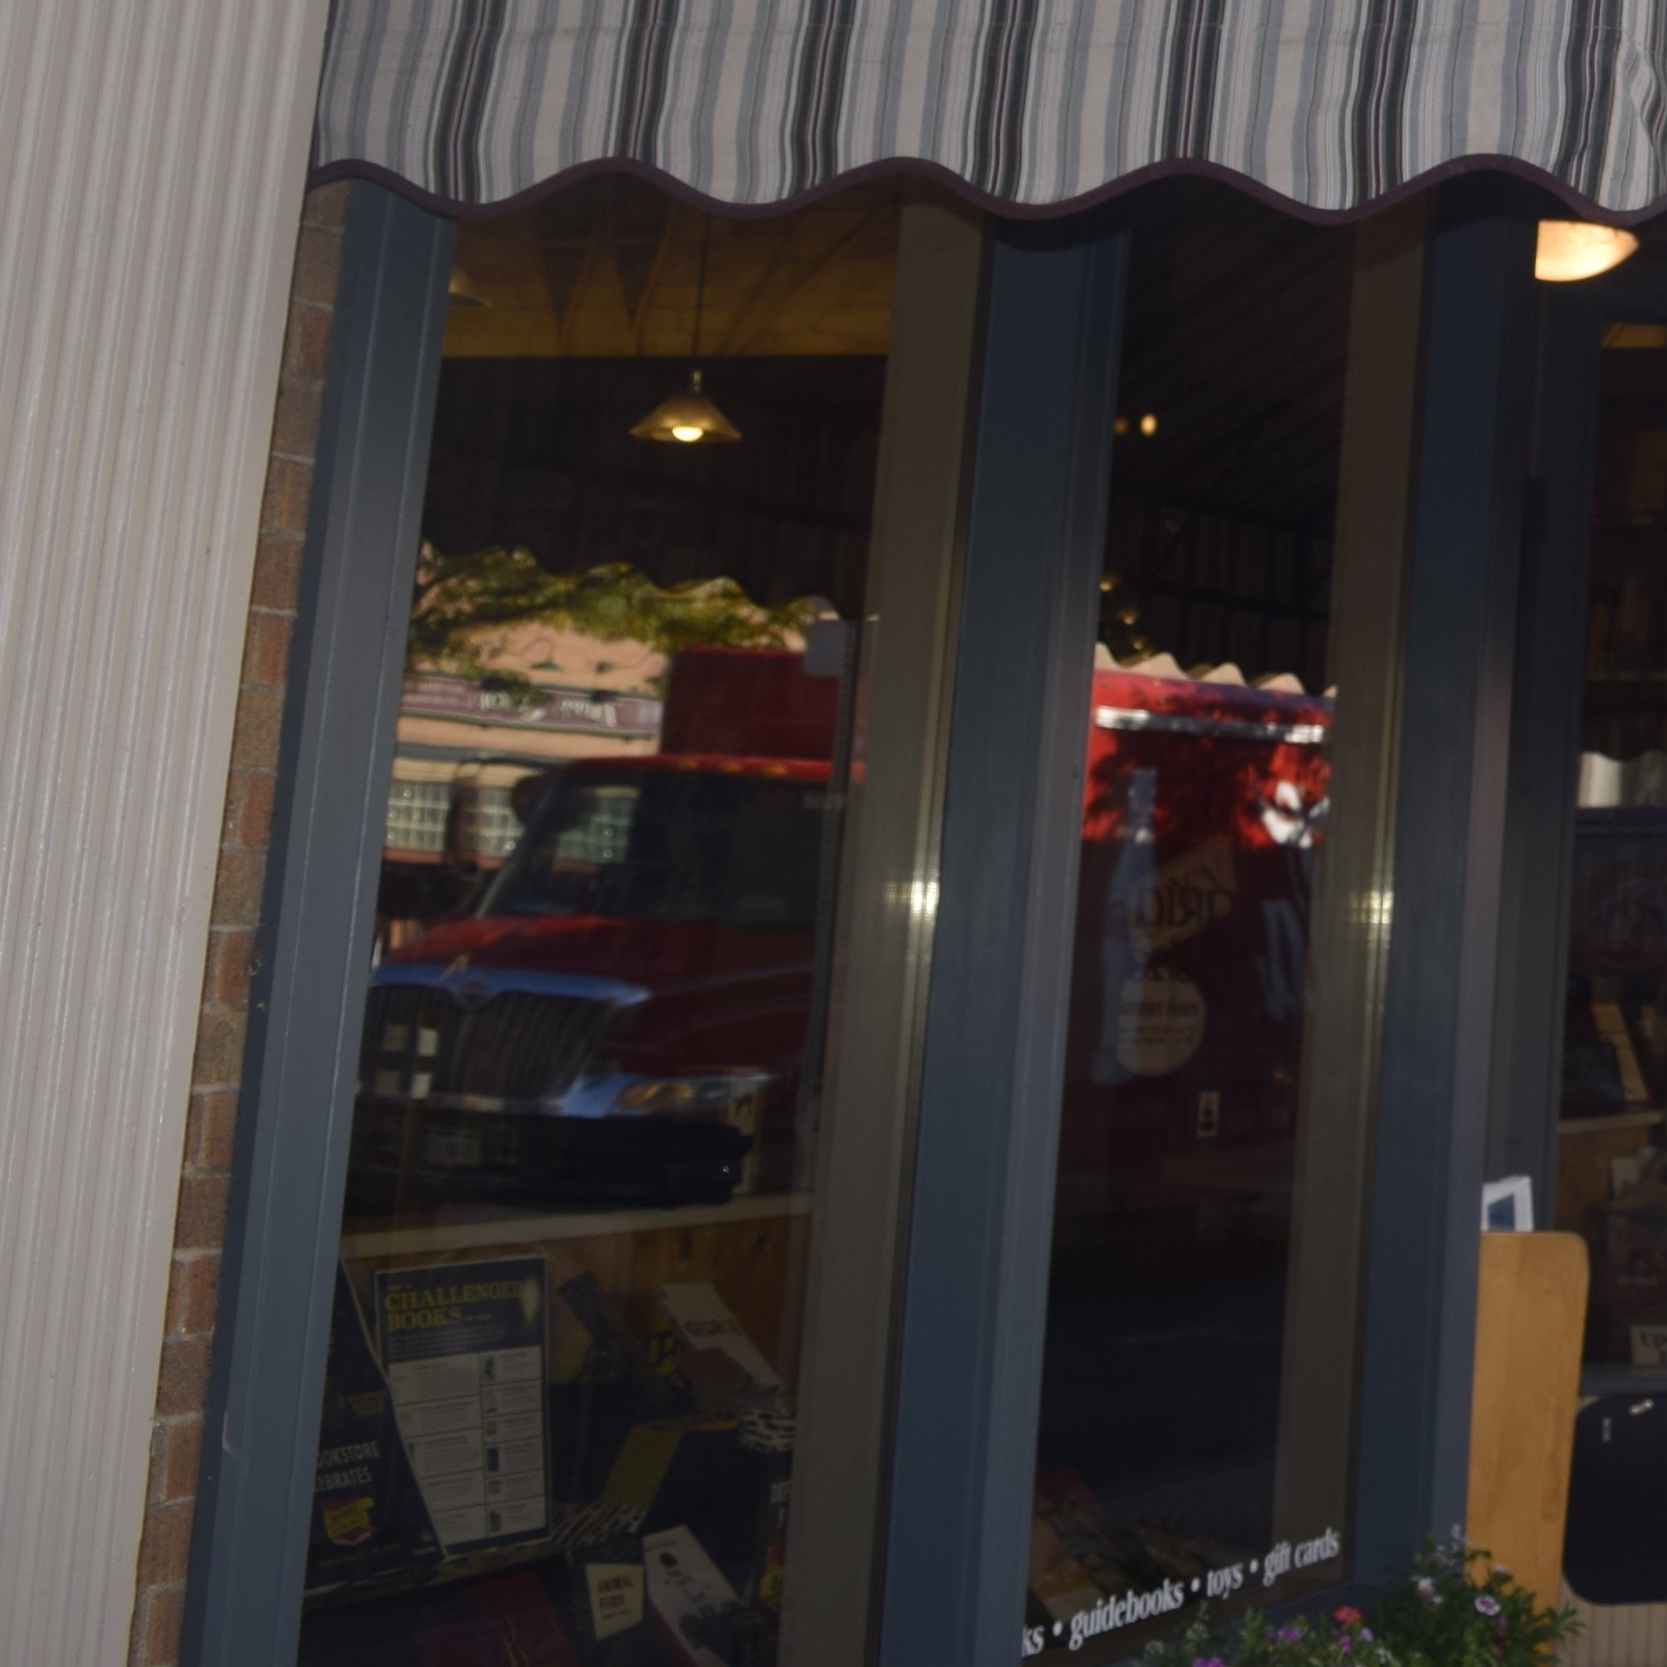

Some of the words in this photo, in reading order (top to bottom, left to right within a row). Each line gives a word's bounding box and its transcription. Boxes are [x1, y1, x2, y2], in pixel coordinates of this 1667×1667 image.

[387, 1307, 462, 1333] BOOKS
[1068, 1577, 1185, 1652] guidebooks
[1205, 1561, 1244, 1600] toys
[1262, 1539, 1292, 1587] gift
[1294, 1526, 1341, 1569] cards
